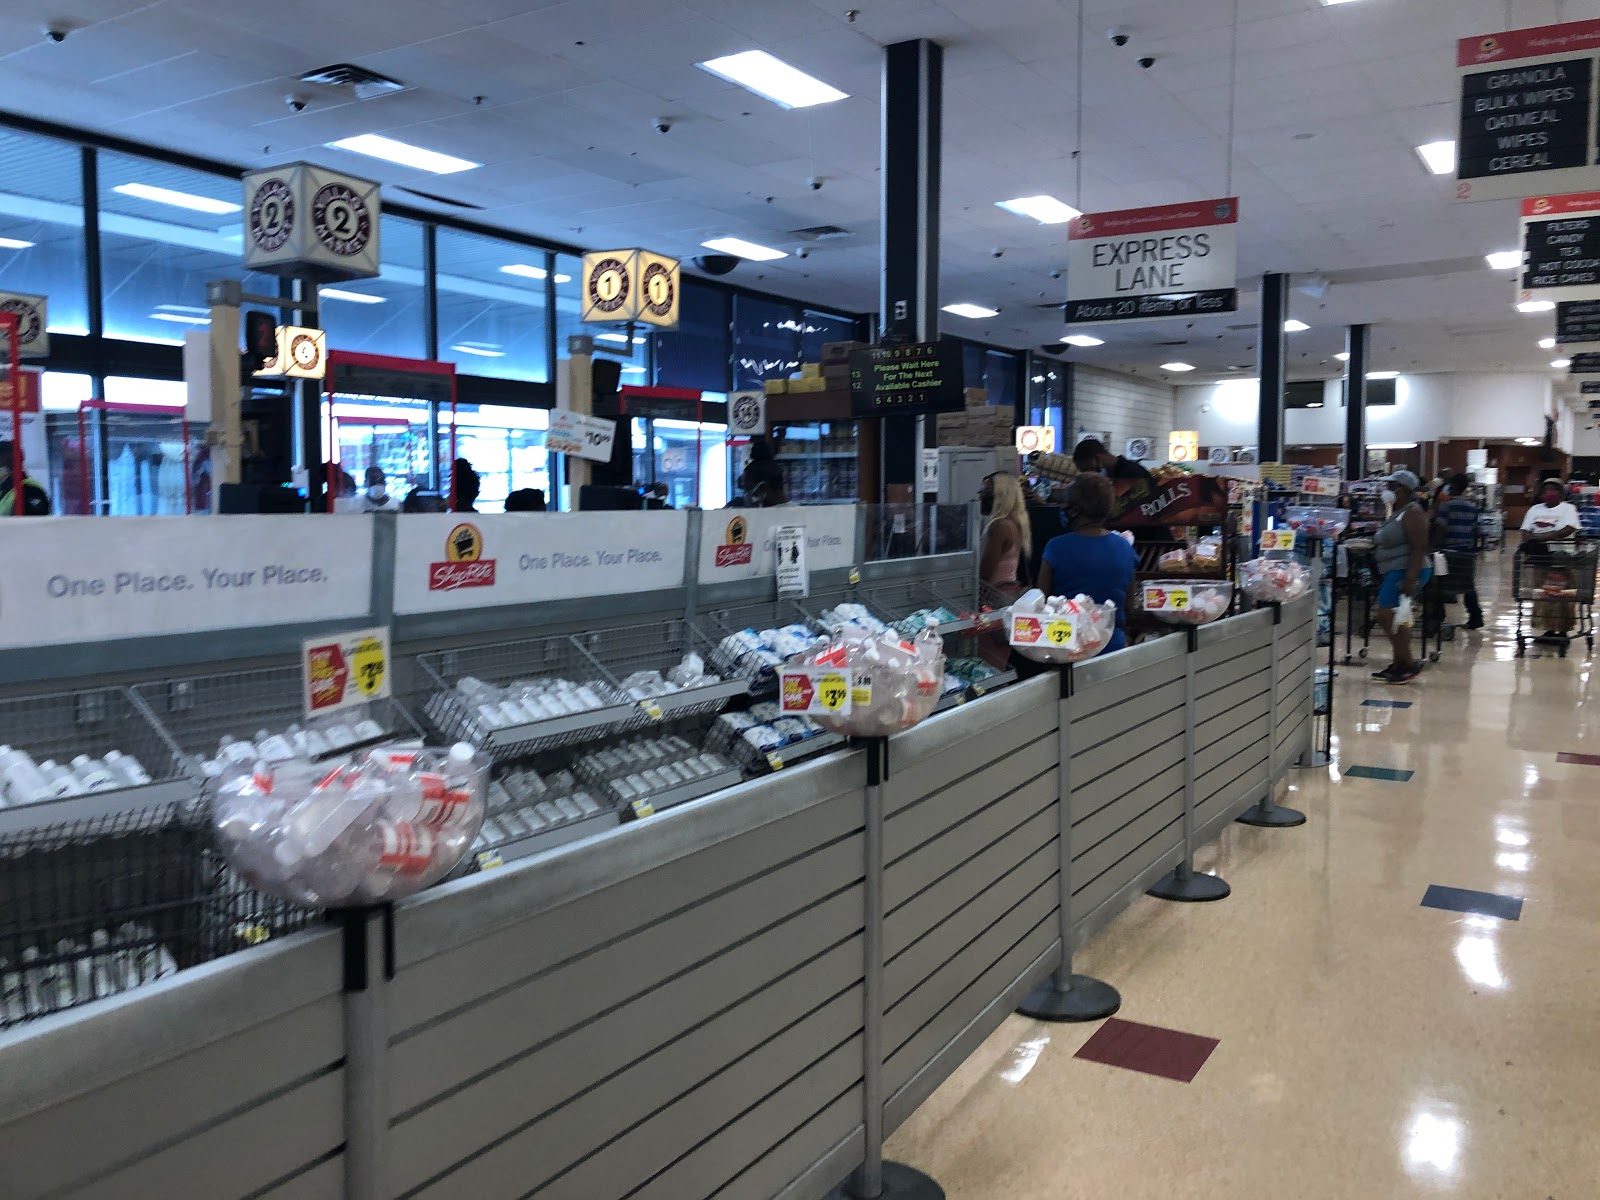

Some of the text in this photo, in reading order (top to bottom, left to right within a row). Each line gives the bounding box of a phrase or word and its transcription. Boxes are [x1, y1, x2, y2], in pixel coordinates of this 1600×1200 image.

[1487, 67, 1567, 90] GRANOLA
[1474, 86, 1576, 113] BULK WIPES
[1484, 109, 1562, 131] OATMEAL
[1497, 131, 1549, 150] WIPES
[1488, 152, 1553, 172] CEREAL
[1457, 182, 1472, 199] 2
[265, 201, 279, 229] 2
[333, 205, 351, 234] 2
[1092, 233, 1211, 268] EXPRESS
[603, 275, 613, 296] 1
[1115, 263, 1185, 292] LANE
[654, 280, 661, 300] 1
[1075, 295, 1224, 318] About 20 items or less
[873, 359, 939, 372] Please Wait Here
[883, 369, 933, 381] For The Next
[852, 382, 861, 390] 12
[875, 379, 942, 391] Available Cashier
[1140, 482, 1192, 517] ROLLS
[518, 548, 662, 571] One Place. Your Place.
[47, 564, 328, 599] One Place. Your Place.
[430, 562, 494, 592] ShopRite
